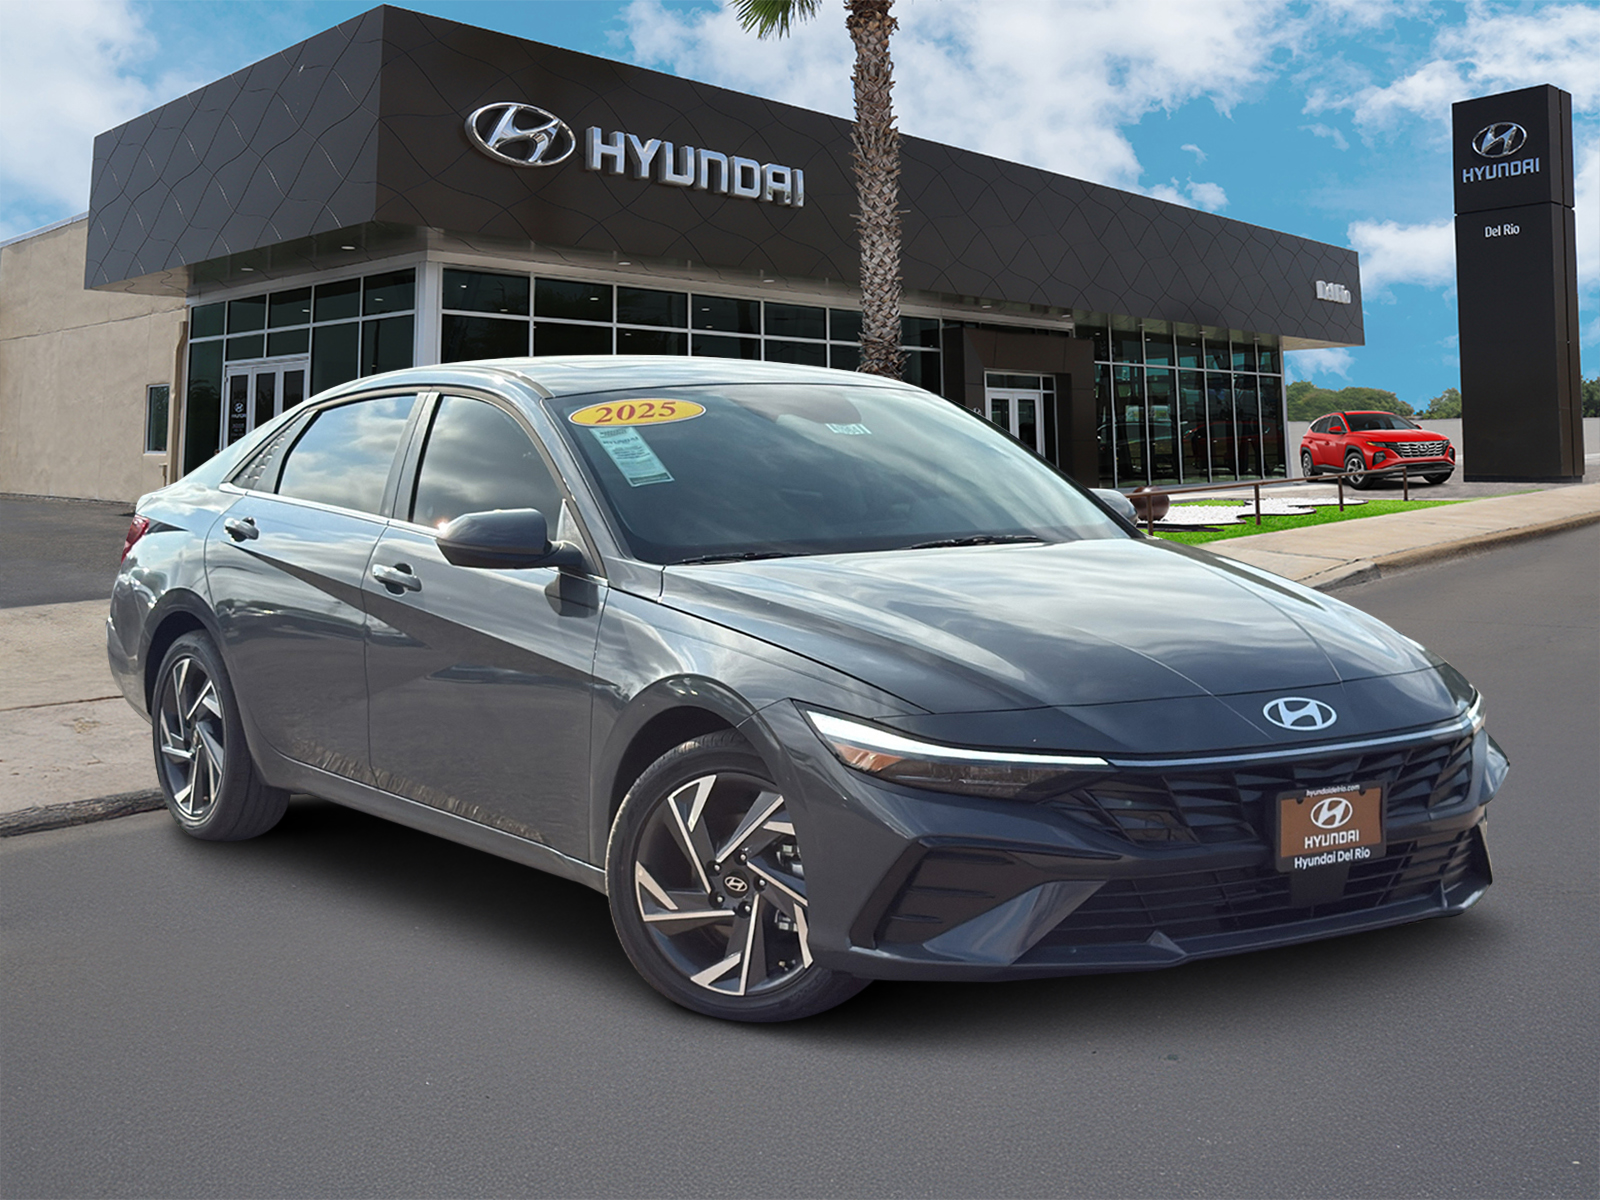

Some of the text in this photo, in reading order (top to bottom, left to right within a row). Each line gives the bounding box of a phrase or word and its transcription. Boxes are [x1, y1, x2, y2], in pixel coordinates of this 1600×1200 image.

[585, 125, 804, 208] HYUNDAI
[1462, 157, 1540, 183] HYUNDAI
[1484, 223, 1520, 238] Del Rio
[594, 401, 676, 424] 2025
[1306, 784, 1360, 798] hyundaidelrio.com
[1304, 829, 1360, 849] HYUNDAI
[1294, 846, 1371, 870] Hyundai Del Rio
